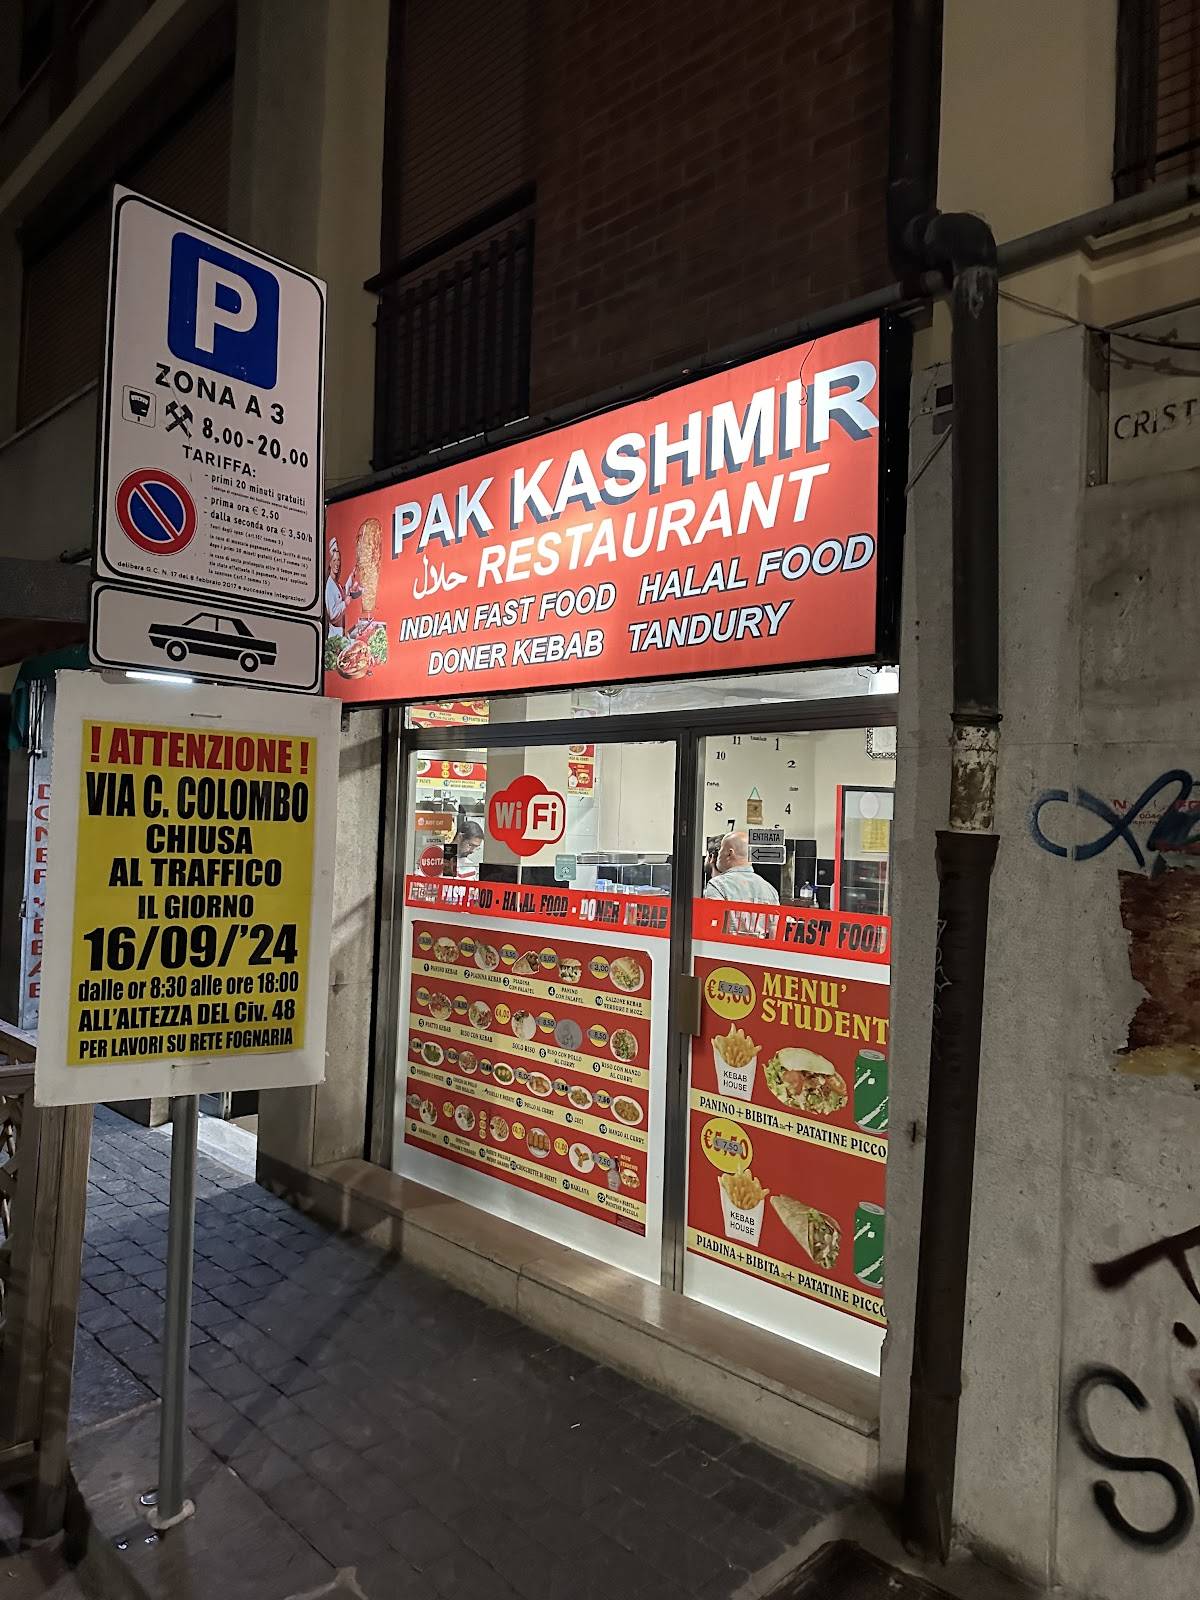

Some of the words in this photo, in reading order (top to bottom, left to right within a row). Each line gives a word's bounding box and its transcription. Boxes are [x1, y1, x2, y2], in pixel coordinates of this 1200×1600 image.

[194, 257, 258, 353] P
[155, 362, 236, 410] ZONA
[245, 394, 262, 418] A
[270, 403, 284, 425] 3
[182, 444, 257, 478] TARIFFA:
[392, 475, 494, 558] PAK
[510, 360, 879, 528] KASHMIR
[210, 497, 234, 510] prima
[237, 504, 249, 513] ora
[211, 473, 233, 487] primi
[235, 479, 247, 490] 20
[249, 484, 275, 498] minuti
[277, 492, 306, 507] gratuiti
[210, 510, 231, 523] dalla
[234, 516, 264, 531] seconda
[266, 525, 278, 534] ora
[477, 464, 829, 587] RESTAURANT
[399, 606, 468, 642] INDIAN
[473, 594, 535, 629] FAST
[538, 582, 617, 622] FOOD
[638, 557, 748, 605] HALAL
[756, 532, 876, 587] FOOD
[413, 554, 468, 600] حلال
[428, 645, 506, 675] DONER
[512, 628, 605, 666] KEBAB
[628, 600, 796, 653] TANDURY
[108, 727, 292, 774] ATTENZIONE
[86, 771, 136, 817] VIA
[143, 774, 169, 819] C.
[177, 775, 309, 823] COLOMBO
[714, 802, 723, 811] 8
[785, 803, 791, 814] 4
[146, 823, 253, 854] CHIUSA
[752, 832, 781, 842] ENTRATA
[108, 857, 143, 887] AL
[151, 858, 282, 887] TRAFFICO
[138, 895, 158, 919] IL
[164, 894, 254, 919] GIORNO
[442, 884, 466, 906] FAST
[502, 890, 536, 913] HALAL
[540, 894, 569, 917] FOOD
[579, 898, 620, 923] DONER
[783, 916, 832, 947] FAST
[836, 921, 888, 954] FOOD
[78, 978, 124, 1002] dalle
[128, 980, 147, 1000] or
[150, 975, 187, 998] 8:30
[190, 974, 222, 996] alle
[226, 975, 254, 994] ore
[257, 970, 299, 993] 18:00
[762, 972, 847, 1008] MENU'
[78, 1003, 193, 1032] ALL'ALTEZZA
[197, 1002, 229, 1025] DEL
[272, 999, 295, 1021] 48
[761, 998, 889, 1045] STUDENT
[79, 1038, 107, 1059] PER
[111, 1035, 163, 1057] LAVORI
[166, 1033, 186, 1053] SU
[189, 1031, 223, 1052] RETE
[226, 1027, 293, 1049] FOGNARIA
[723, 1070, 748, 1083] KEBAB
[723, 1079, 748, 1092] HOUSE
[699, 1096, 735, 1115] PANINO
[745, 1108, 779, 1129] BIBITA
[796, 1122, 848, 1147] PATATINE
[730, 1211, 755, 1226] KEBAB
[730, 1220, 755, 1236] HOUSE
[696, 1234, 735, 1260] PIADINA
[746, 1253, 780, 1277] BIBITA
[797, 1273, 849, 1303] PATATINE
